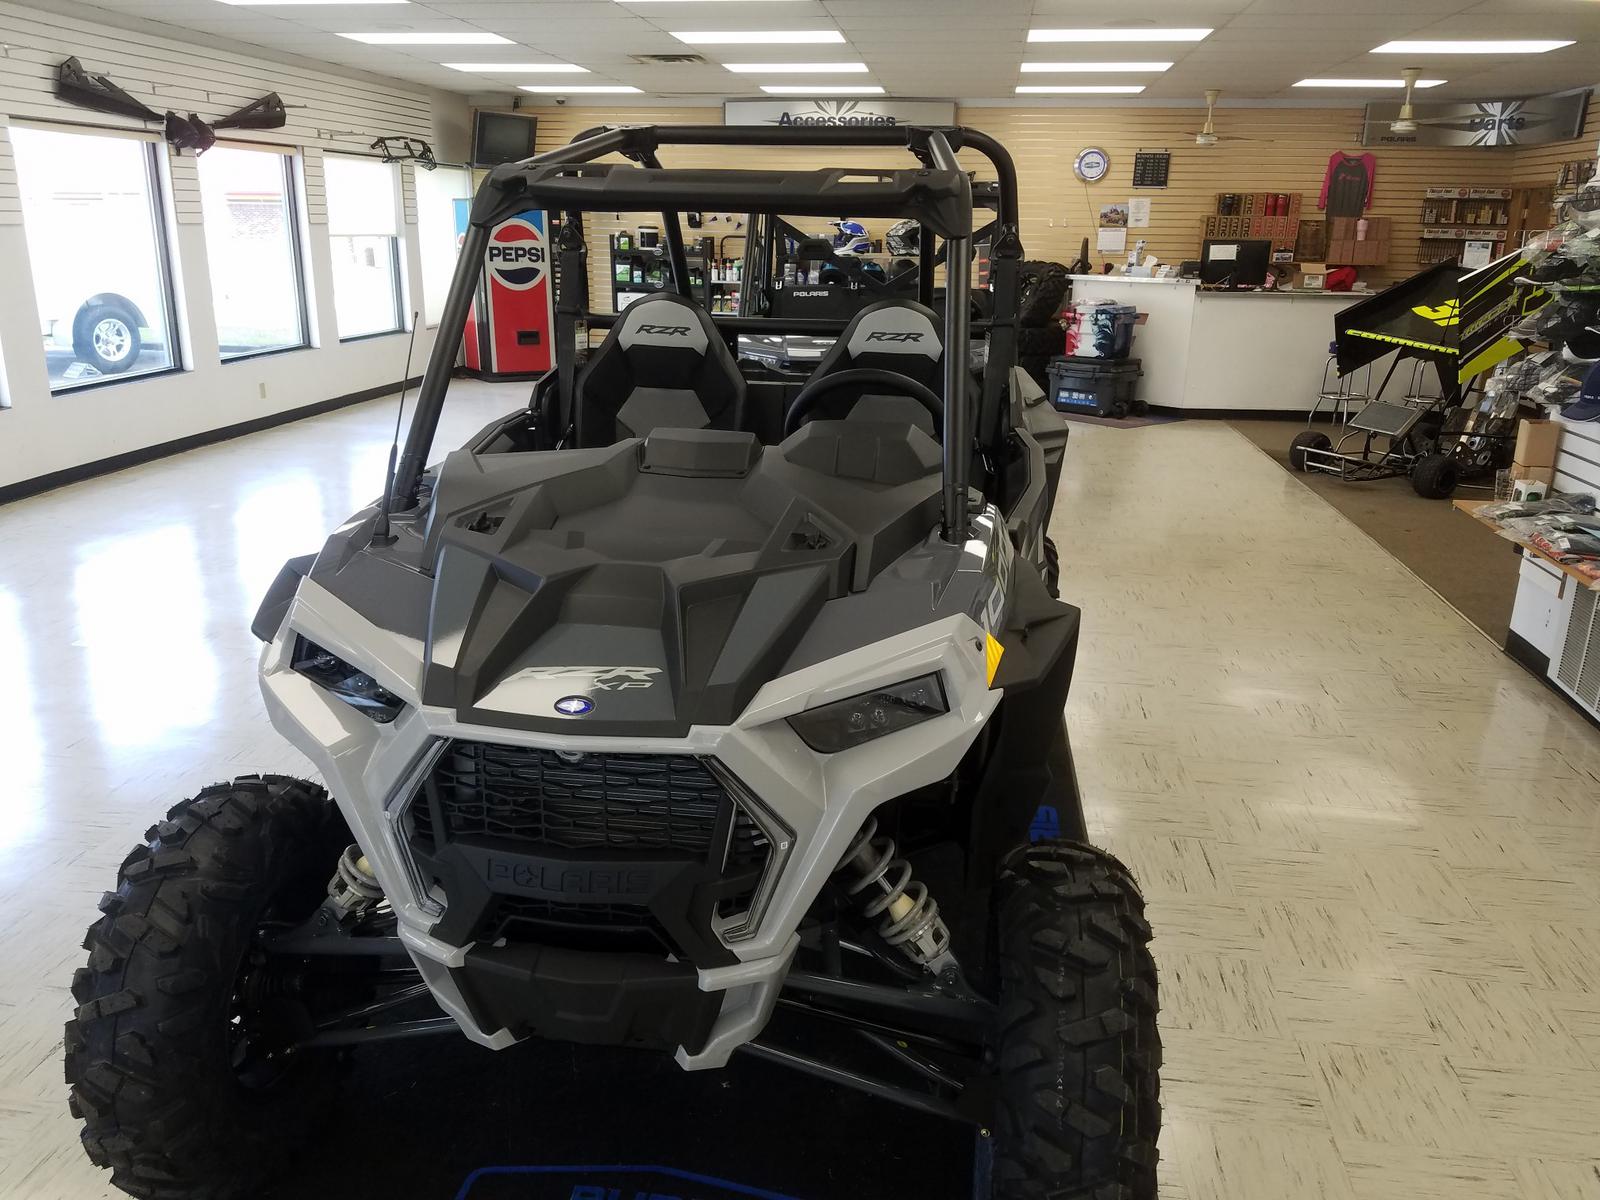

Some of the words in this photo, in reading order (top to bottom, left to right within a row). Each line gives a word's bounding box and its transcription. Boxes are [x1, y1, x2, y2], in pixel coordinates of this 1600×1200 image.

[779, 111, 897, 126] Accessories
[488, 246, 546, 263] PEPSI
[635, 324, 692, 336] RZR
[865, 331, 925, 343] RZR
[516, 666, 664, 681] RZR
[585, 681, 654, 691] XP
[486, 855, 652, 895] POLARIS
